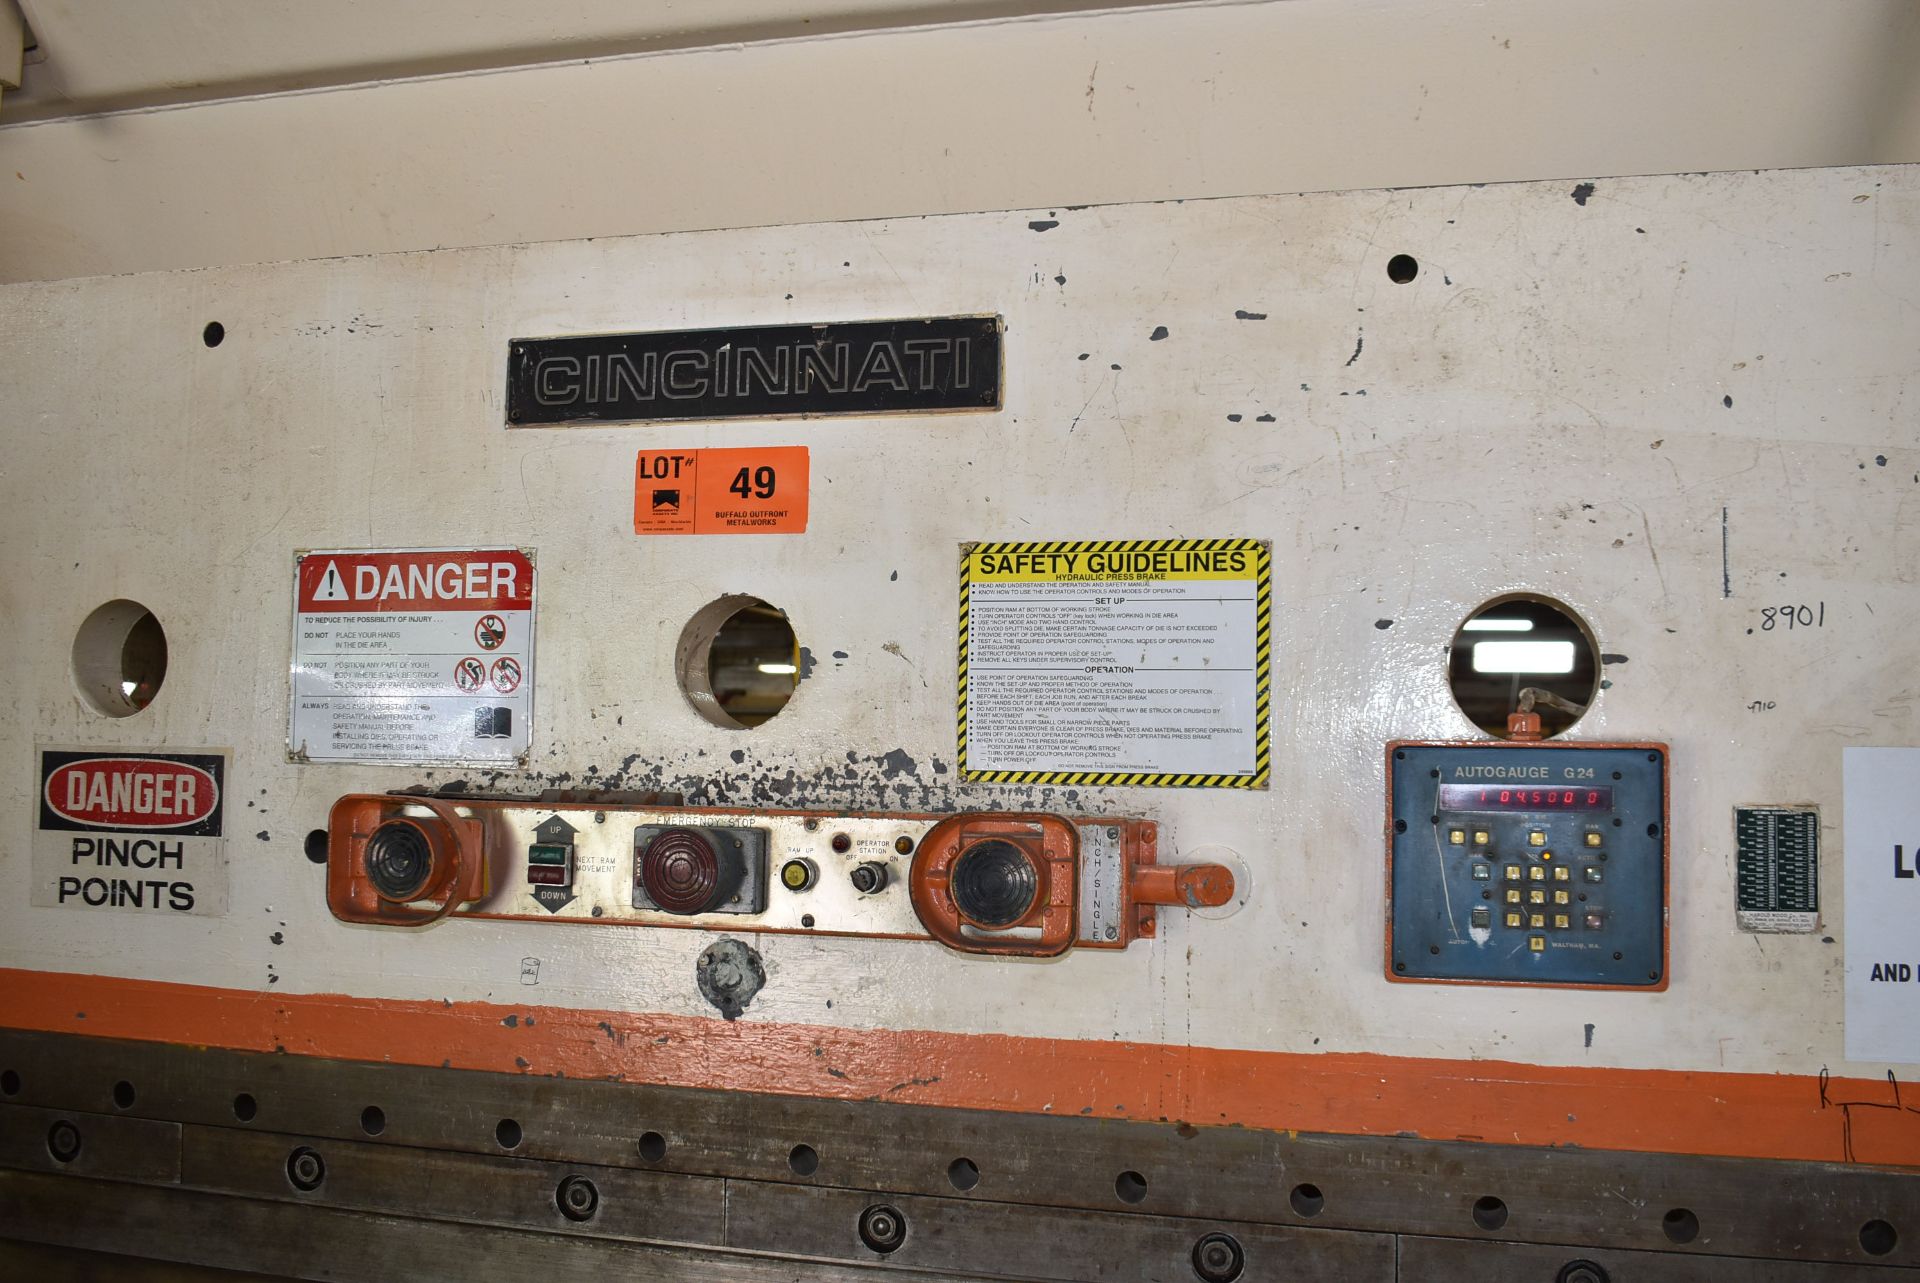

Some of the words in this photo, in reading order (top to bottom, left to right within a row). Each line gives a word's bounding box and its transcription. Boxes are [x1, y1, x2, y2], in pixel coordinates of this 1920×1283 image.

[534, 338, 971, 407] CINCINNATI
[729, 466, 776, 499] 49
[750, 510, 788, 518] OUTFRONT
[980, 554, 1079, 574] SAFETY
[1088, 551, 1246, 573] GUIDELINES
[355, 562, 517, 601] DANGER
[1454, 766, 1550, 778] AUTOGAUGE
[67, 770, 196, 816] DANGER
[656, 816, 720, 826] EMERGENCY
[728, 816, 756, 828] STOP
[72, 837, 184, 870] PINCH
[576, 856, 595, 864] NEXT
[576, 864, 616, 873] MOVEMENT
[58, 876, 195, 911] POINTS
[541, 891, 566, 901] DOWN
[1870, 963, 1911, 982] AND
